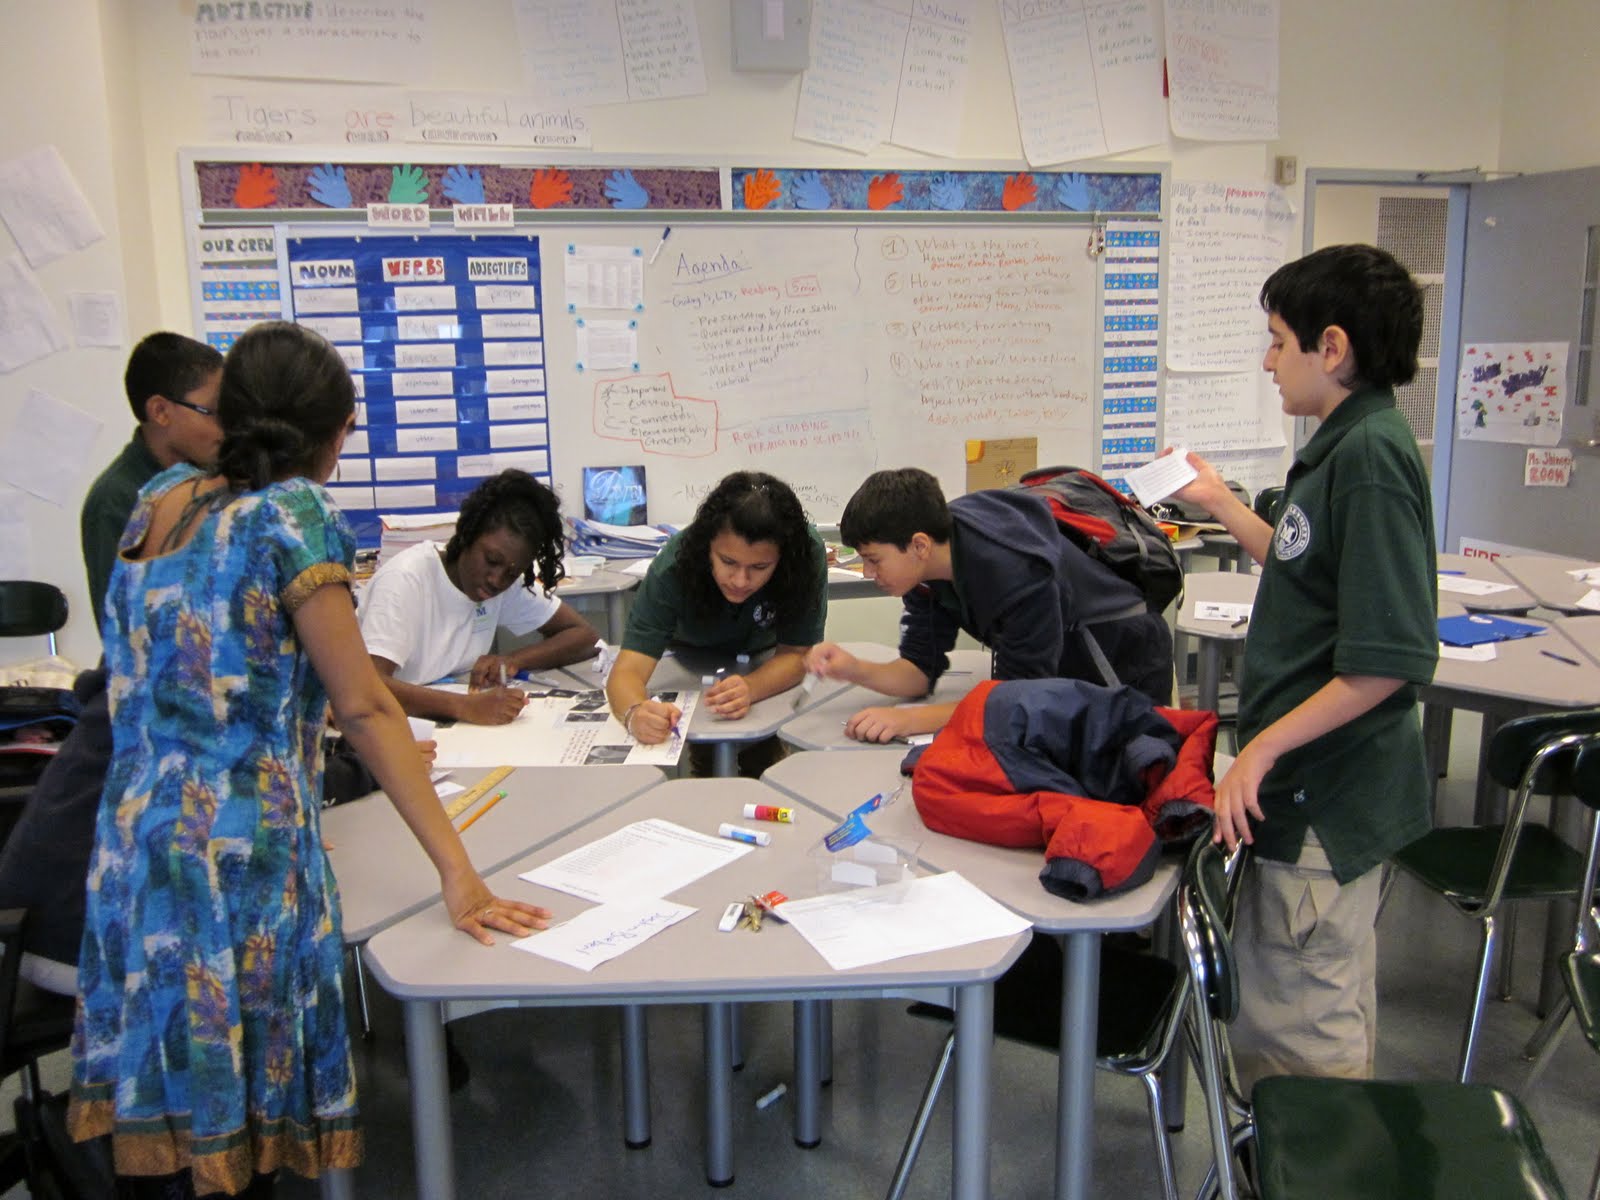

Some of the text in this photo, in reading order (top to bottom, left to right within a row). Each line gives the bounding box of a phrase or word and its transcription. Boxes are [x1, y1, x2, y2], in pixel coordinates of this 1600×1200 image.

[212, 95, 318, 131] Tigers
[345, 108, 400, 128] are
[409, 100, 511, 128] beautiful
[1225, 186, 1266, 202] pronoun
[370, 207, 510, 222] WORD WALL
[202, 237, 274, 253] OUR CREW
[915, 238, 956, 253] What
[965, 240, 976, 250] is
[299, 264, 354, 280] NOUNS
[387, 259, 443, 276] VERBS
[469, 261, 527, 276] ADJECTIVES
[676, 252, 742, 280] Agenda
[911, 272, 942, 289] How
